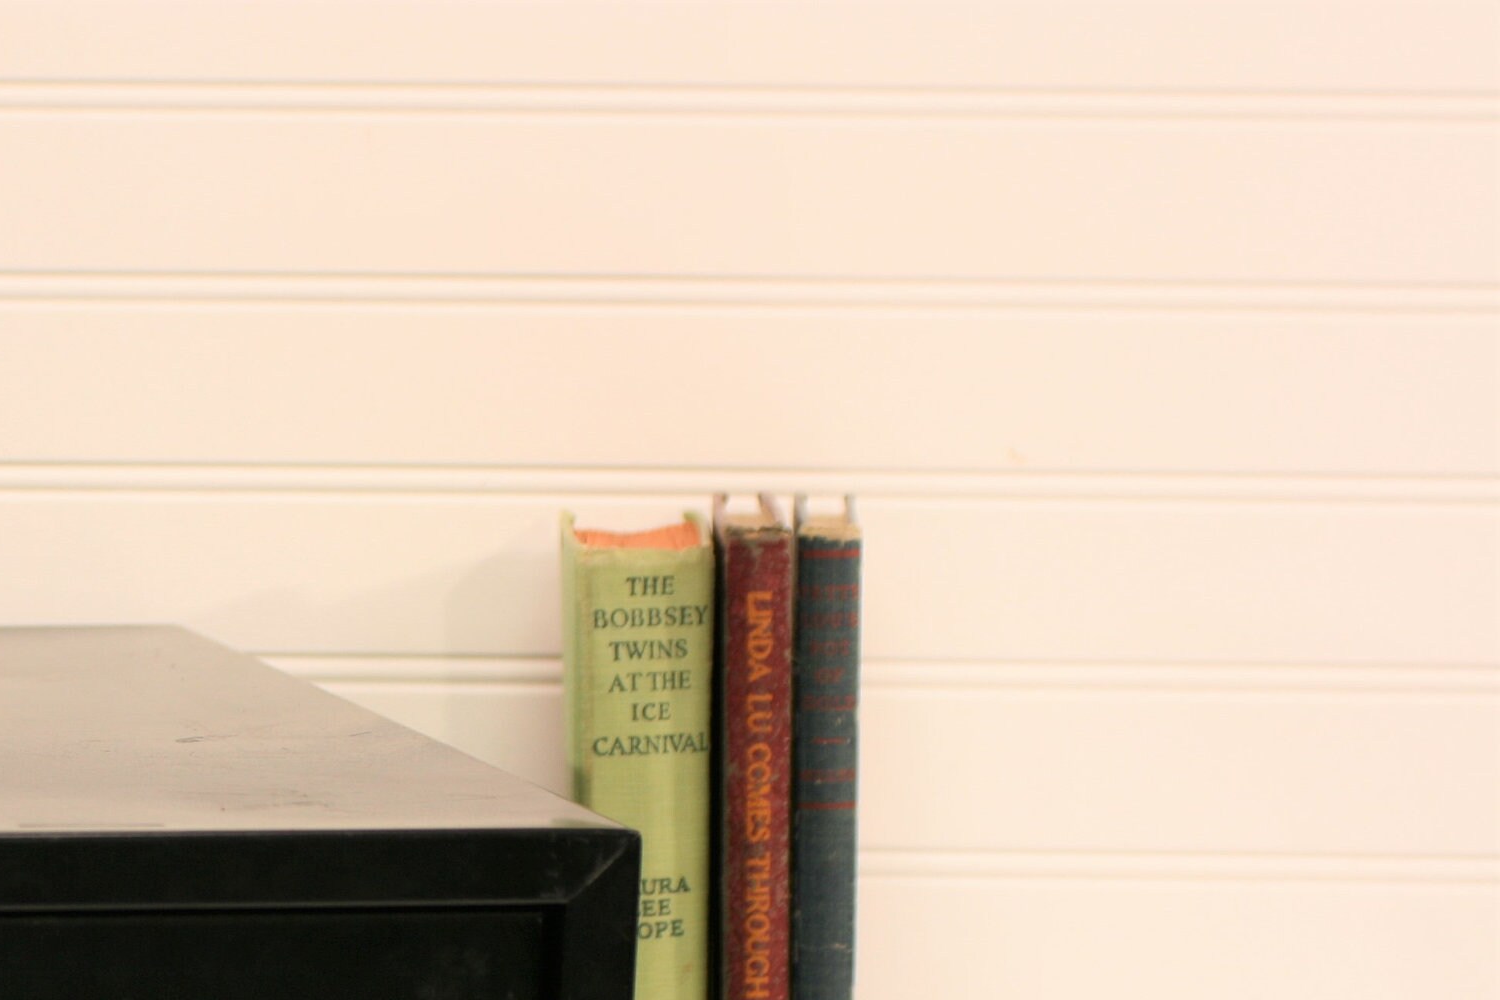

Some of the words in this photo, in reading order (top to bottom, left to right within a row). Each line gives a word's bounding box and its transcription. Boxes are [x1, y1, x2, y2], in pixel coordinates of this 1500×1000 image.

[625, 575, 675, 596] THE
[592, 605, 709, 629] BOBBSEY
[746, 591, 774, 682] LINDA
[609, 638, 688, 661] TWINS
[608, 672, 645, 693] AT
[645, 670, 691, 691] THE
[631, 703, 671, 722] ICE
[746, 693, 774, 733] LU
[592, 732, 709, 757] CARNIVAL
[745, 742, 773, 842] COMES
[639, 876, 691, 895] URA
[637, 898, 671, 917] EE
[636, 919, 685, 939] OPE
[743, 853, 772, 999] THROUGH
